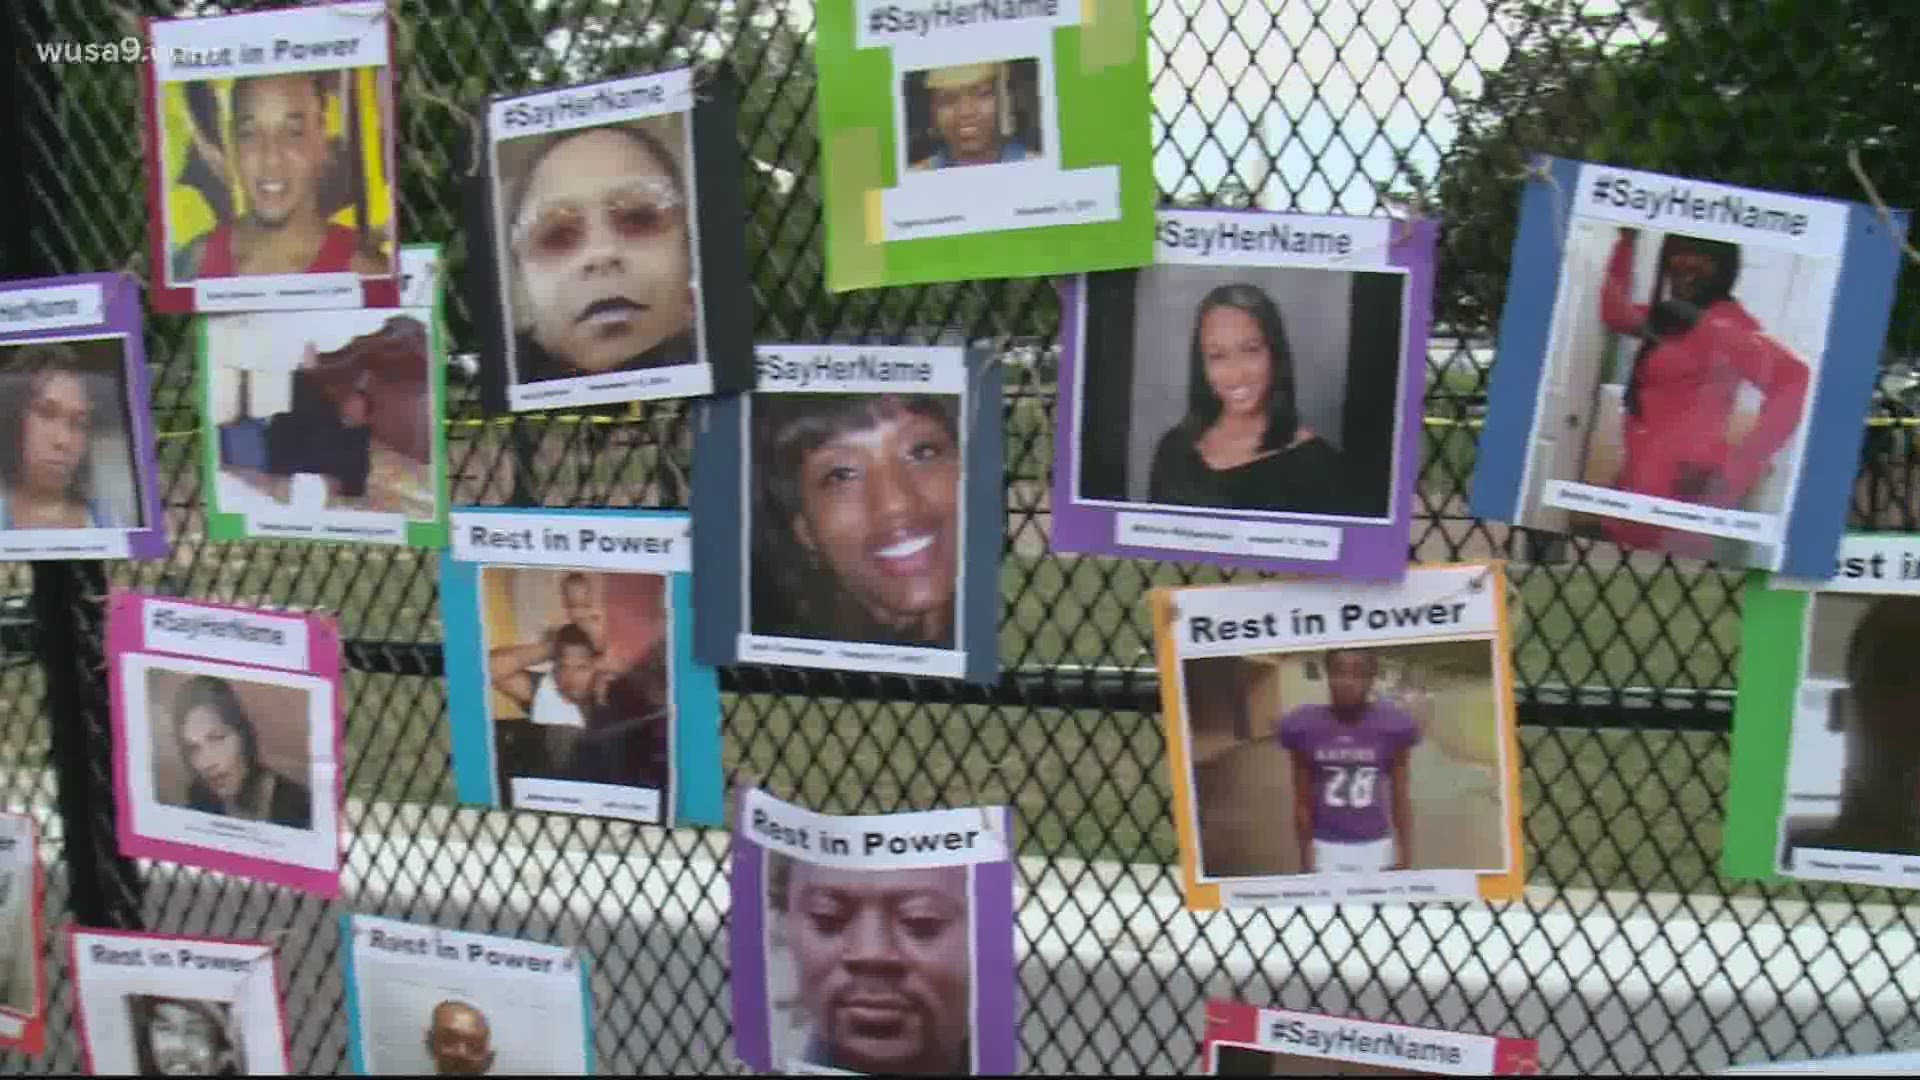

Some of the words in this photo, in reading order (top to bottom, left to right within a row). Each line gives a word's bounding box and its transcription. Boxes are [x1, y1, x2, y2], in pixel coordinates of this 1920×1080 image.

[867, 0, 1057, 37] #SayHerName
[274, 37, 360, 61] Power
[1593, 177, 1809, 236] #SayHerName
[470, 525, 535, 551] Rest
[543, 528, 570, 552] in
[578, 529, 675, 555] Power
[1834, 550, 1887, 578] st
[1190, 612, 1278, 644] Rest
[1291, 608, 1325, 636] in
[1341, 601, 1466, 632] Power
[1321, 766, 1379, 808] 28
[753, 808, 810, 850] Rest
[819, 831, 849, 856] in
[864, 830, 979, 856] Power
[91, 944, 146, 966] Rest
[150, 950, 174, 966] in
[177, 949, 251, 972] Power
[370, 929, 428, 954] Rest
[435, 934, 459, 961] in
[467, 943, 552, 972] Power
[1269, 1018, 1462, 1066] #SayHerName
